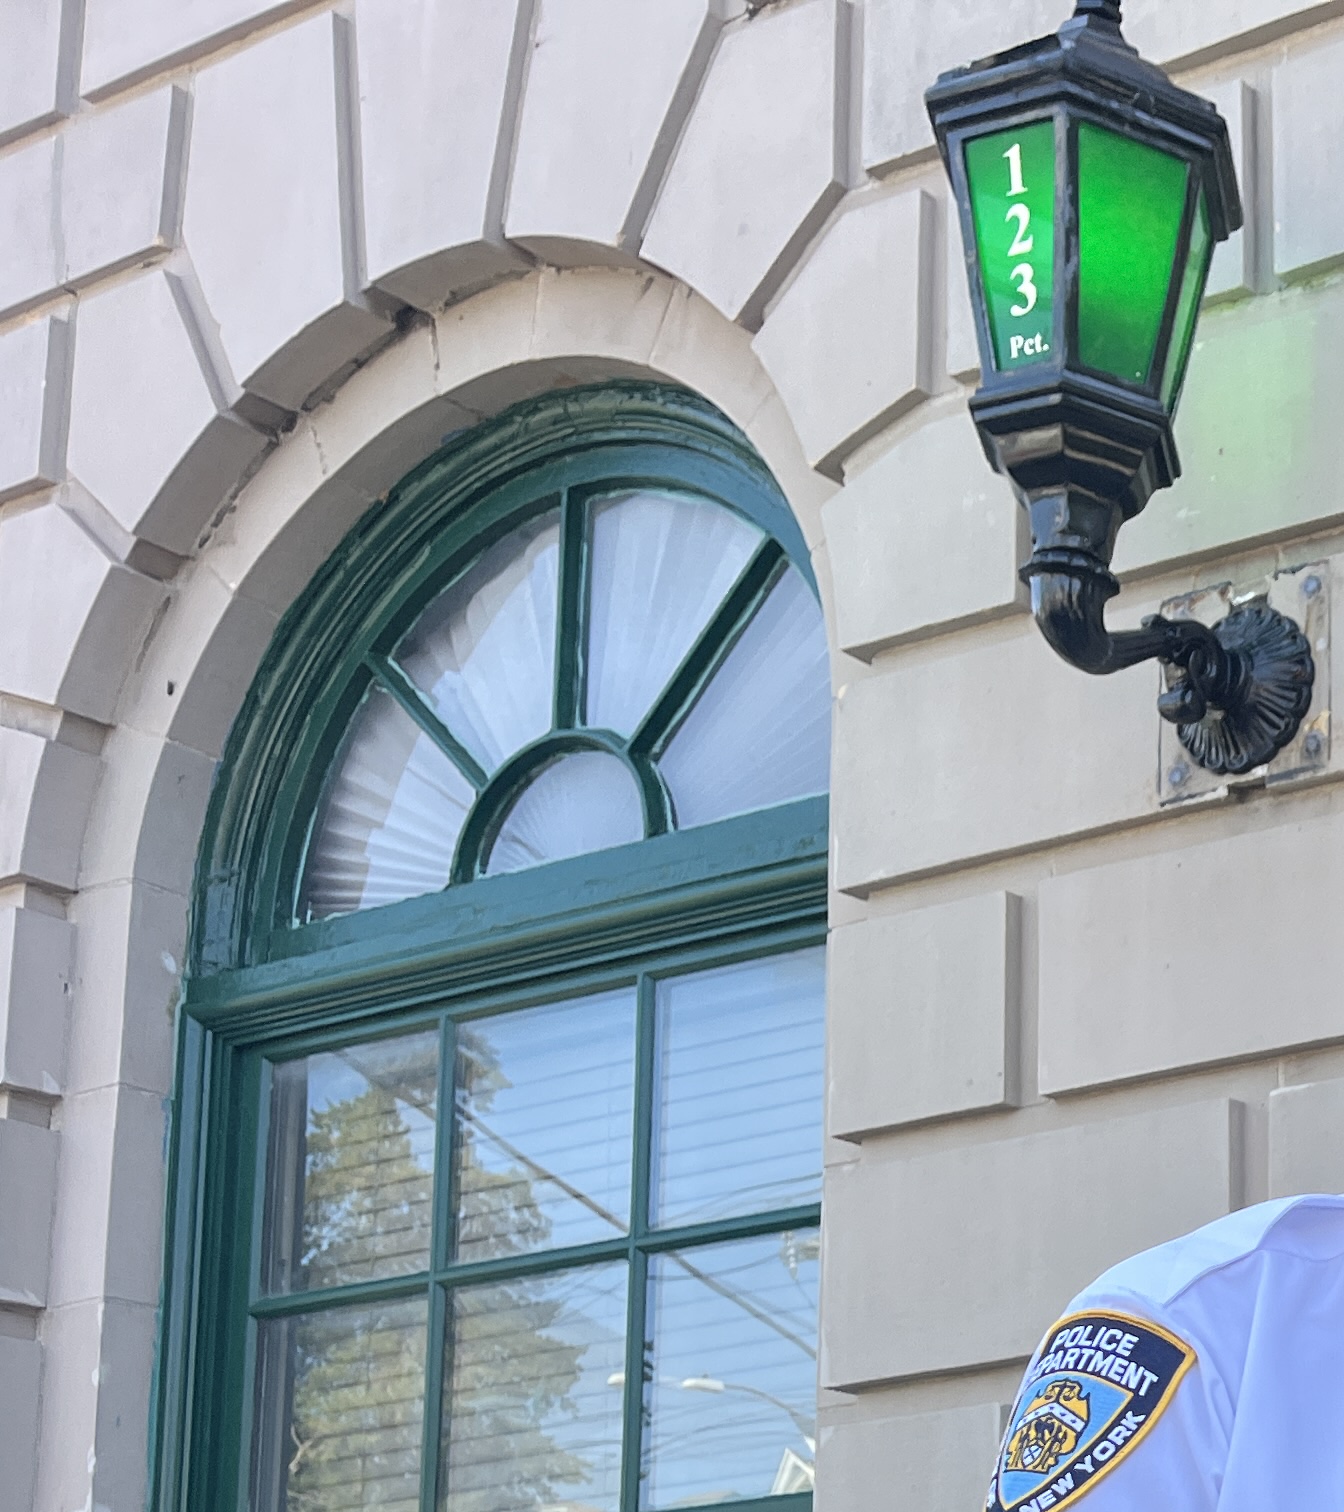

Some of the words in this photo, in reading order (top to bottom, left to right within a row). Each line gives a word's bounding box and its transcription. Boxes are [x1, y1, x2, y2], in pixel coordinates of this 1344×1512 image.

[1003, 143, 1037, 317] 123
[1009, 331, 1049, 359] Pct.
[1049, 1324, 1139, 1356] POLICE
[1073, 1410, 1147, 1474] YORK
